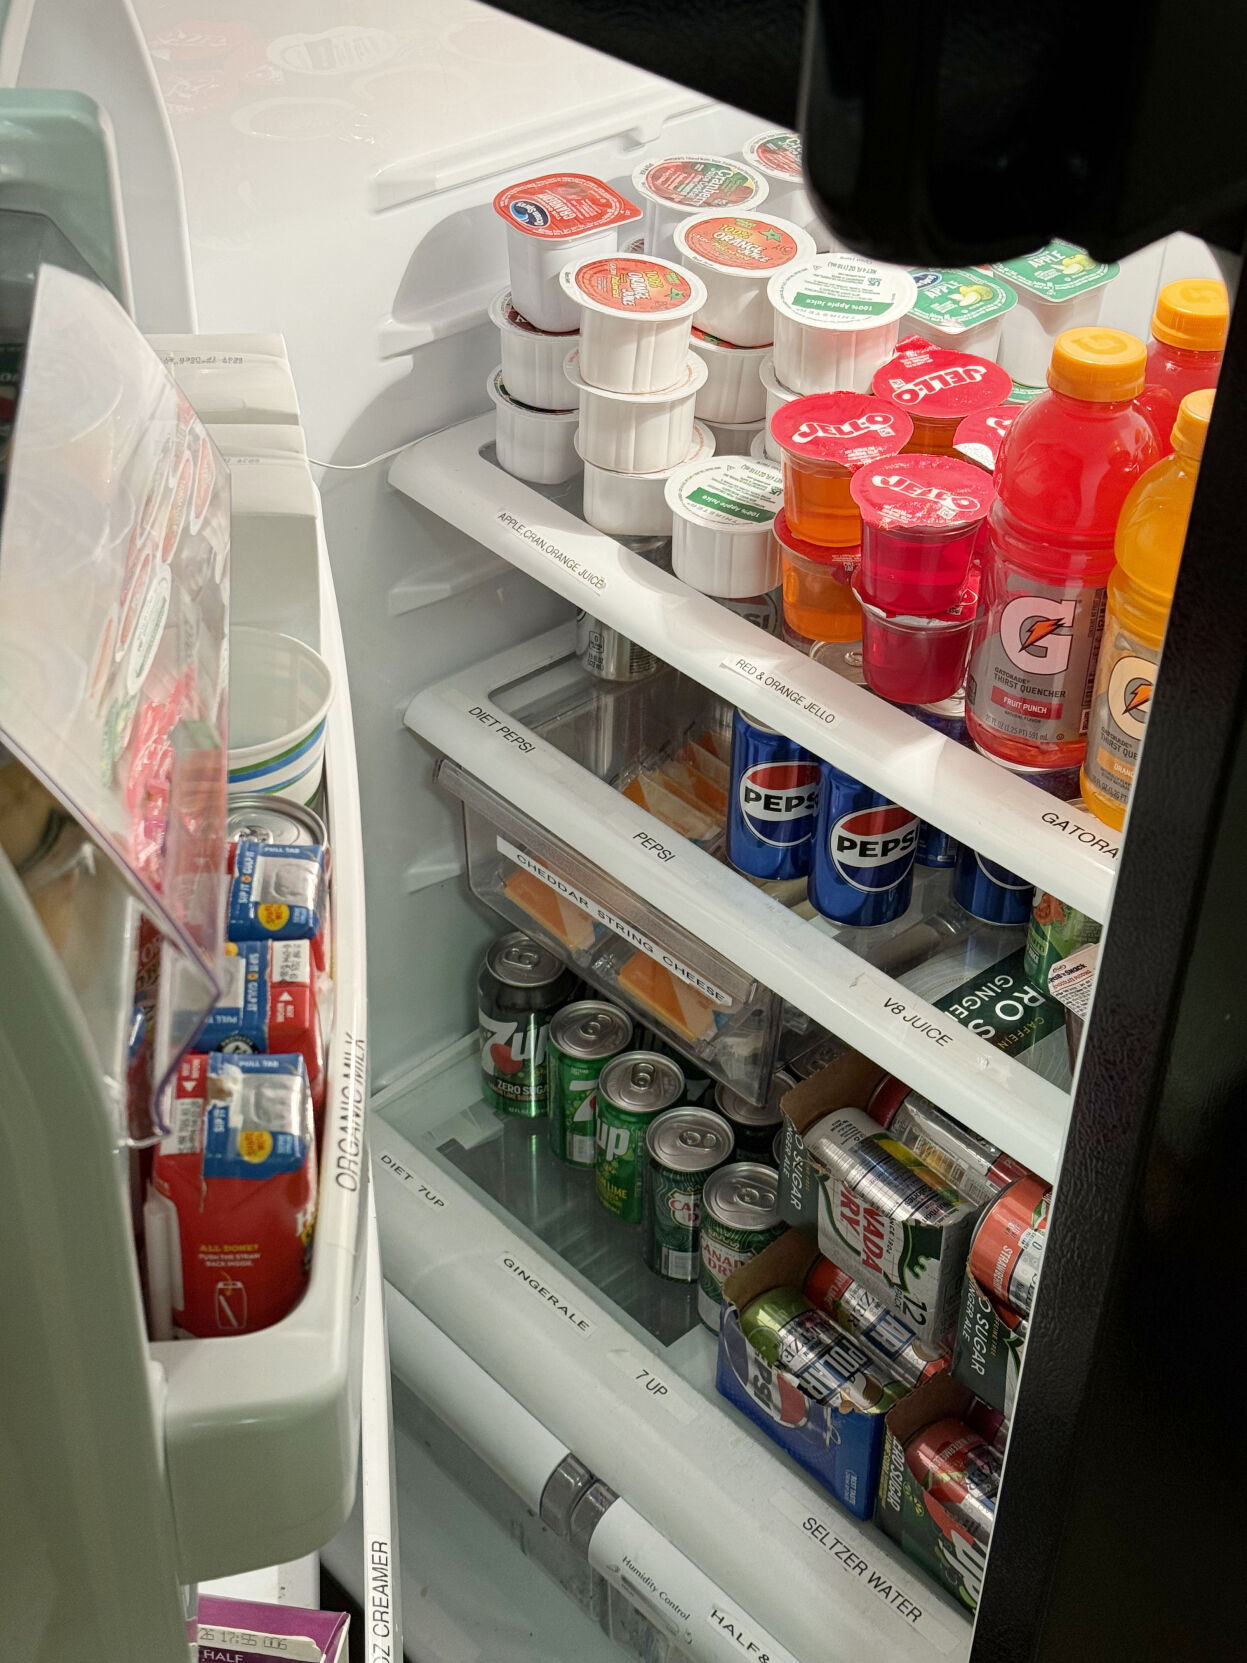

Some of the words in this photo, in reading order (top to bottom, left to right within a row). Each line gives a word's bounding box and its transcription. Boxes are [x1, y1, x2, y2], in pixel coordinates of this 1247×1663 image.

[714, 232, 766, 253] ORANGE
[720, 224, 751, 239] 100%
[1027, 250, 1066, 268] APPLE
[628, 272, 650, 300] ORANGE
[644, 271, 664, 290] 100%
[924, 280, 962, 299] APPLE
[806, 298, 826, 308] Juice
[828, 301, 850, 310] Apple
[851, 304, 872, 312] 100%
[702, 494, 720, 505] Juice
[720, 502, 740, 514] Apple
[578, 562, 604, 588] JUICE
[1000, 596, 1077, 675] G
[735, 658, 757, 676] RED
[754, 670, 764, 682] &
[764, 676, 808, 706] ORANGE
[804, 699, 836, 724] JELLO
[994, 673, 1019, 690] THIRST
[1020, 684, 1066, 698] QUENCHER
[1003, 696, 1022, 710] FRUIT
[1023, 702, 1048, 714] PUNCH
[468, 706, 498, 730] DIET
[495, 724, 536, 754] PEPSI
[1100, 732, 1121, 753] THIRST
[744, 786, 819, 814] PEPS
[632, 831, 676, 863] PEPSI
[836, 827, 919, 858] PEPS
[1041, 811, 1120, 860] GATORA
[516, 854, 590, 909] CHEDDAR
[597, 908, 655, 954] STRING
[662, 955, 726, 1003] CHEESE
[943, 974, 1014, 1023] GINGE
[883, 997, 906, 1016] V8
[902, 1012, 953, 1048] JUICE
[997, 1016, 1045, 1050] CAFFEIN
[497, 1080, 521, 1094] ZERO
[522, 1086, 547, 1096] SUG
[596, 1123, 630, 1161] up
[380, 1154, 414, 1180] DIET
[418, 1184, 446, 1210] 7UP
[782, 1158, 792, 1178] ALE
[670, 1199, 701, 1212] CAN
[200, 1244, 222, 1252] ALL
[700, 1237, 745, 1267] ANAD
[861, 1205, 886, 1272] NADA
[502, 1257, 591, 1332] GINGERALE
[966, 1280, 976, 1319] INGER
[904, 1294, 928, 1326] 12
[962, 1319, 972, 1342] ALE
[971, 1313, 990, 1376] SUGAR
[635, 1368, 649, 1381] 7
[645, 1377, 669, 1398] UP
[796, 1336, 869, 1401] POLAR
[889, 1466, 902, 1512] SUGAR
[802, 1516, 868, 1576] SELTZER
[868, 1570, 924, 1624] WATER
[371, 1540, 390, 1638] CREAMER
[622, 1555, 659, 1595] Humidity
[658, 1590, 691, 1622] Control
